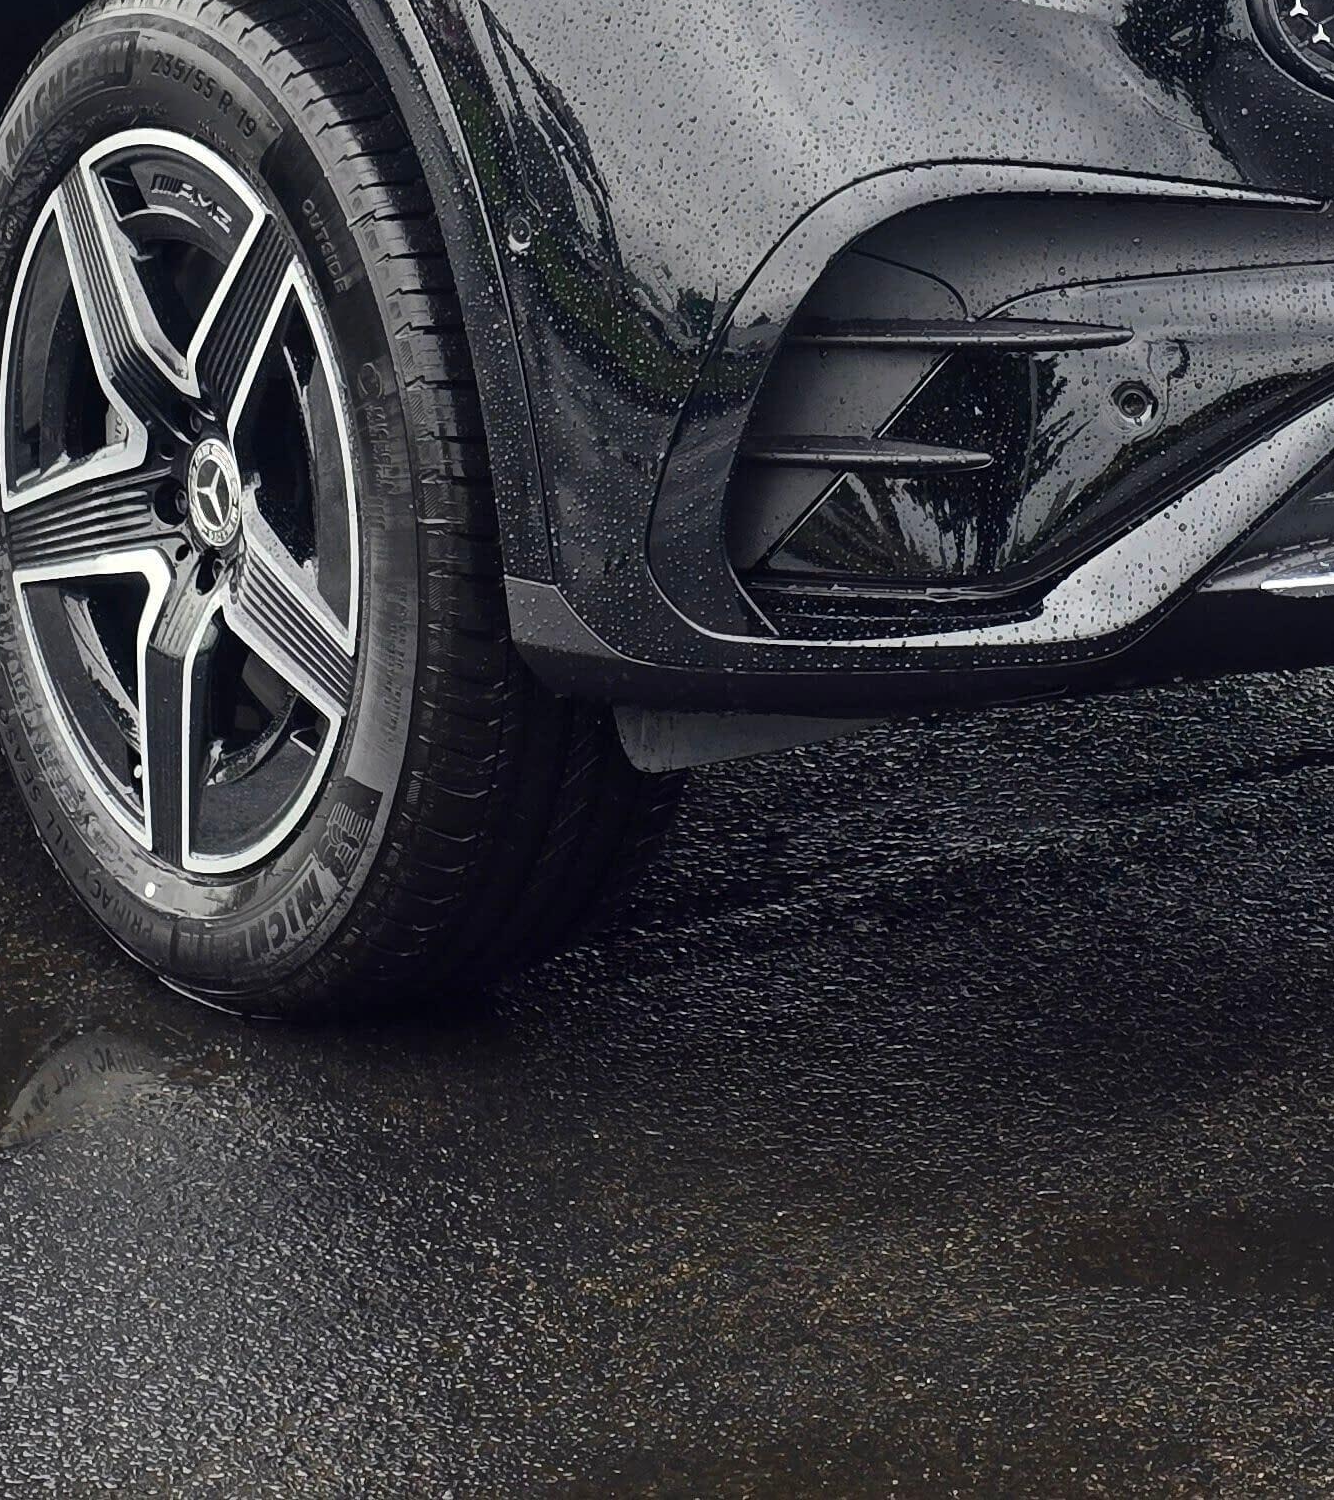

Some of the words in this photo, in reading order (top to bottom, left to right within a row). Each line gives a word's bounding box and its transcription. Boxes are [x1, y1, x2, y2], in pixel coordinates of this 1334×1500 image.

[4, 38, 129, 163] MICHELIN
[150, 50, 218, 100] 235/55
[218, 89, 234, 115] R
[236, 109, 257, 139] 19
[301, 198, 348, 294] OUTSIDE
[79, 866, 155, 938] PRIMACY
